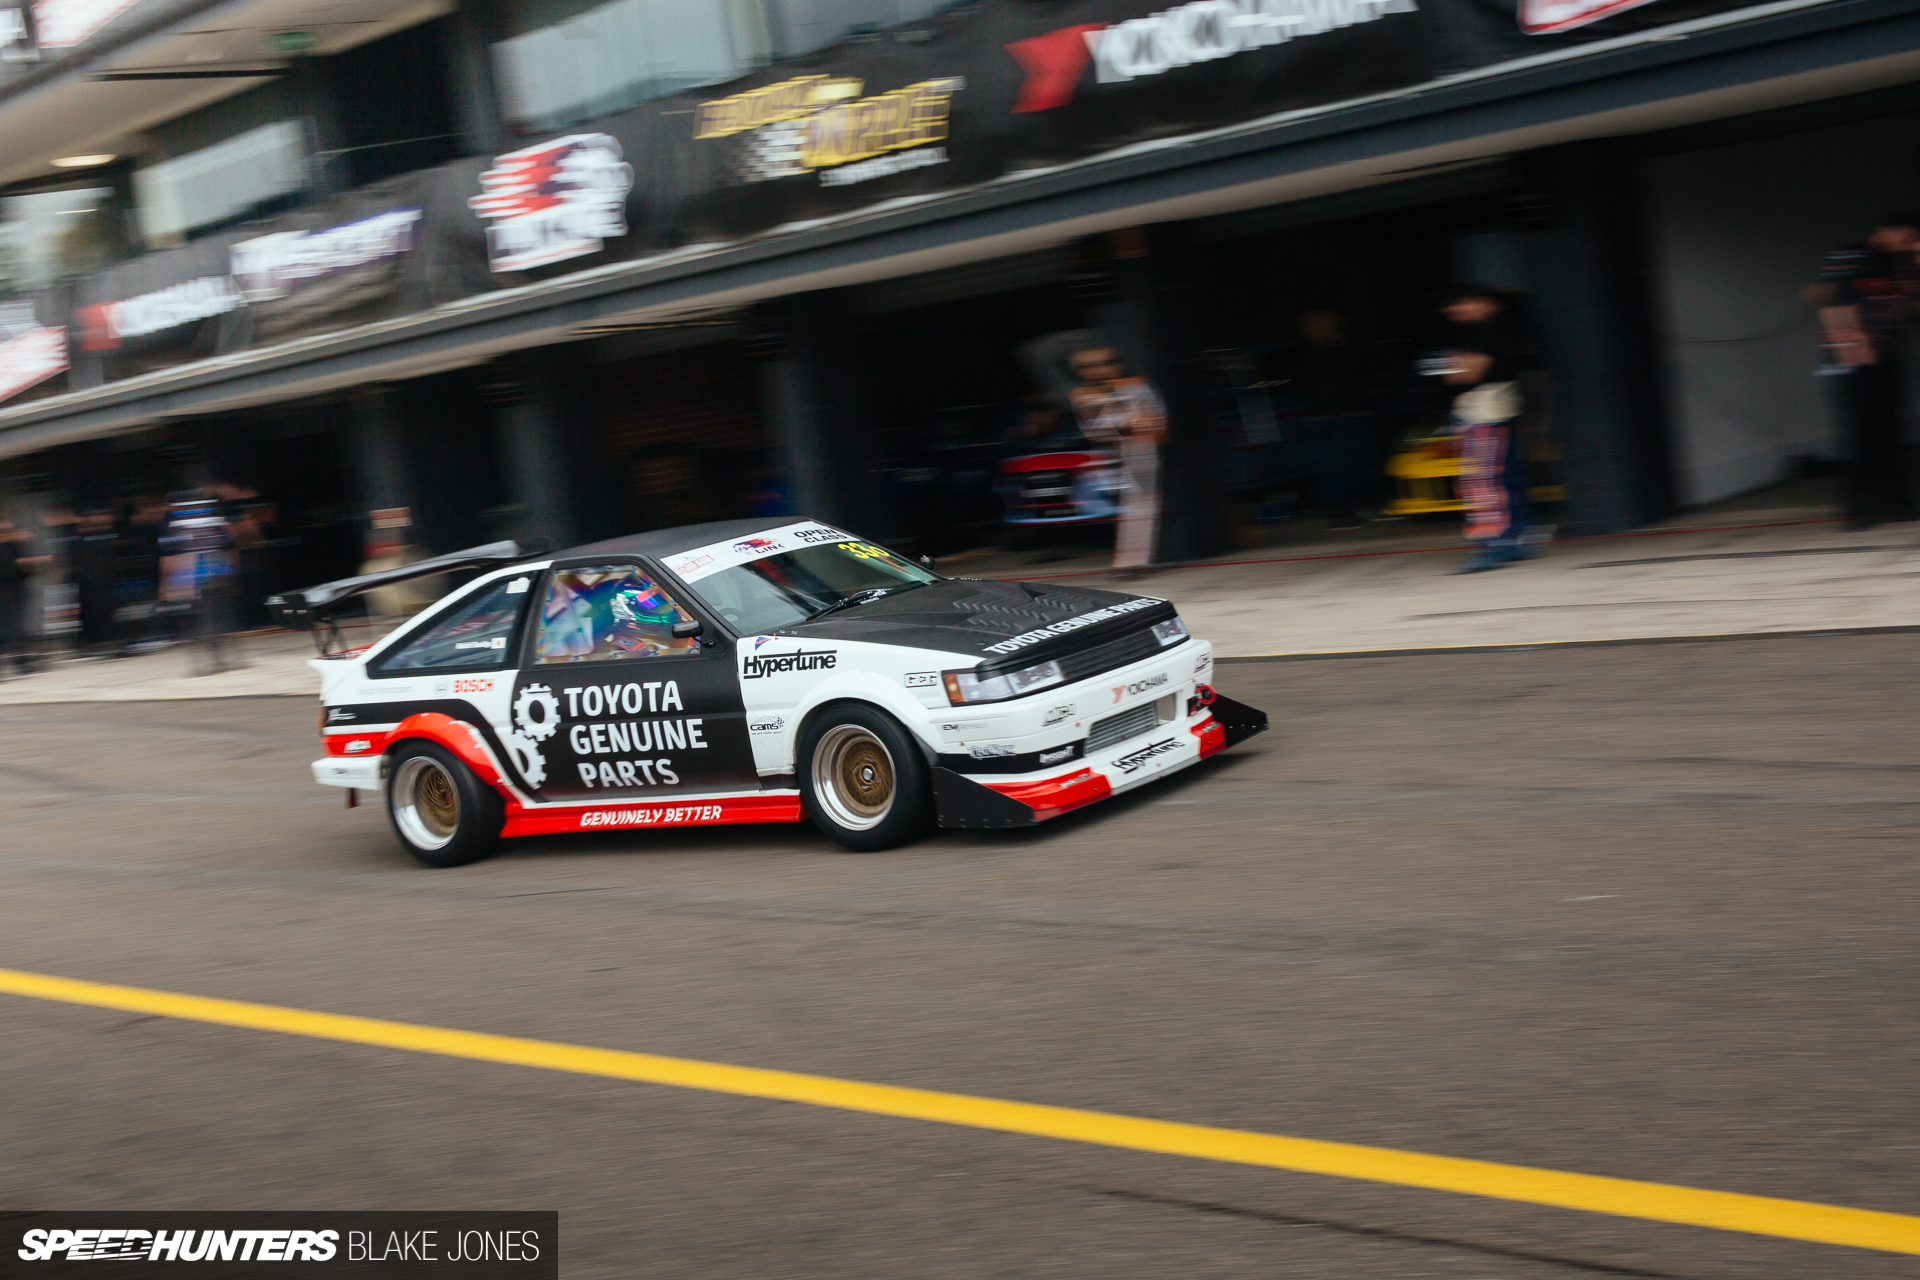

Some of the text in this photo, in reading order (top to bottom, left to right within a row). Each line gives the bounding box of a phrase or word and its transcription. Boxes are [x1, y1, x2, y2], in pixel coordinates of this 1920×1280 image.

[794, 527, 838, 538] OPEN
[803, 533, 848, 543] CLASS
[837, 541, 890, 559] 330
[982, 598, 1162, 654] TOYOTA GENUINE PARTS
[743, 648, 837, 680] Hypertune
[453, 678, 495, 693] BOSCH
[563, 680, 684, 717] TOYOTA
[569, 718, 708, 755] GENUINE
[750, 723, 779, 731] cams
[577, 758, 680, 788] PARTS
[579, 805, 722, 827] GENUINELY BETTER
